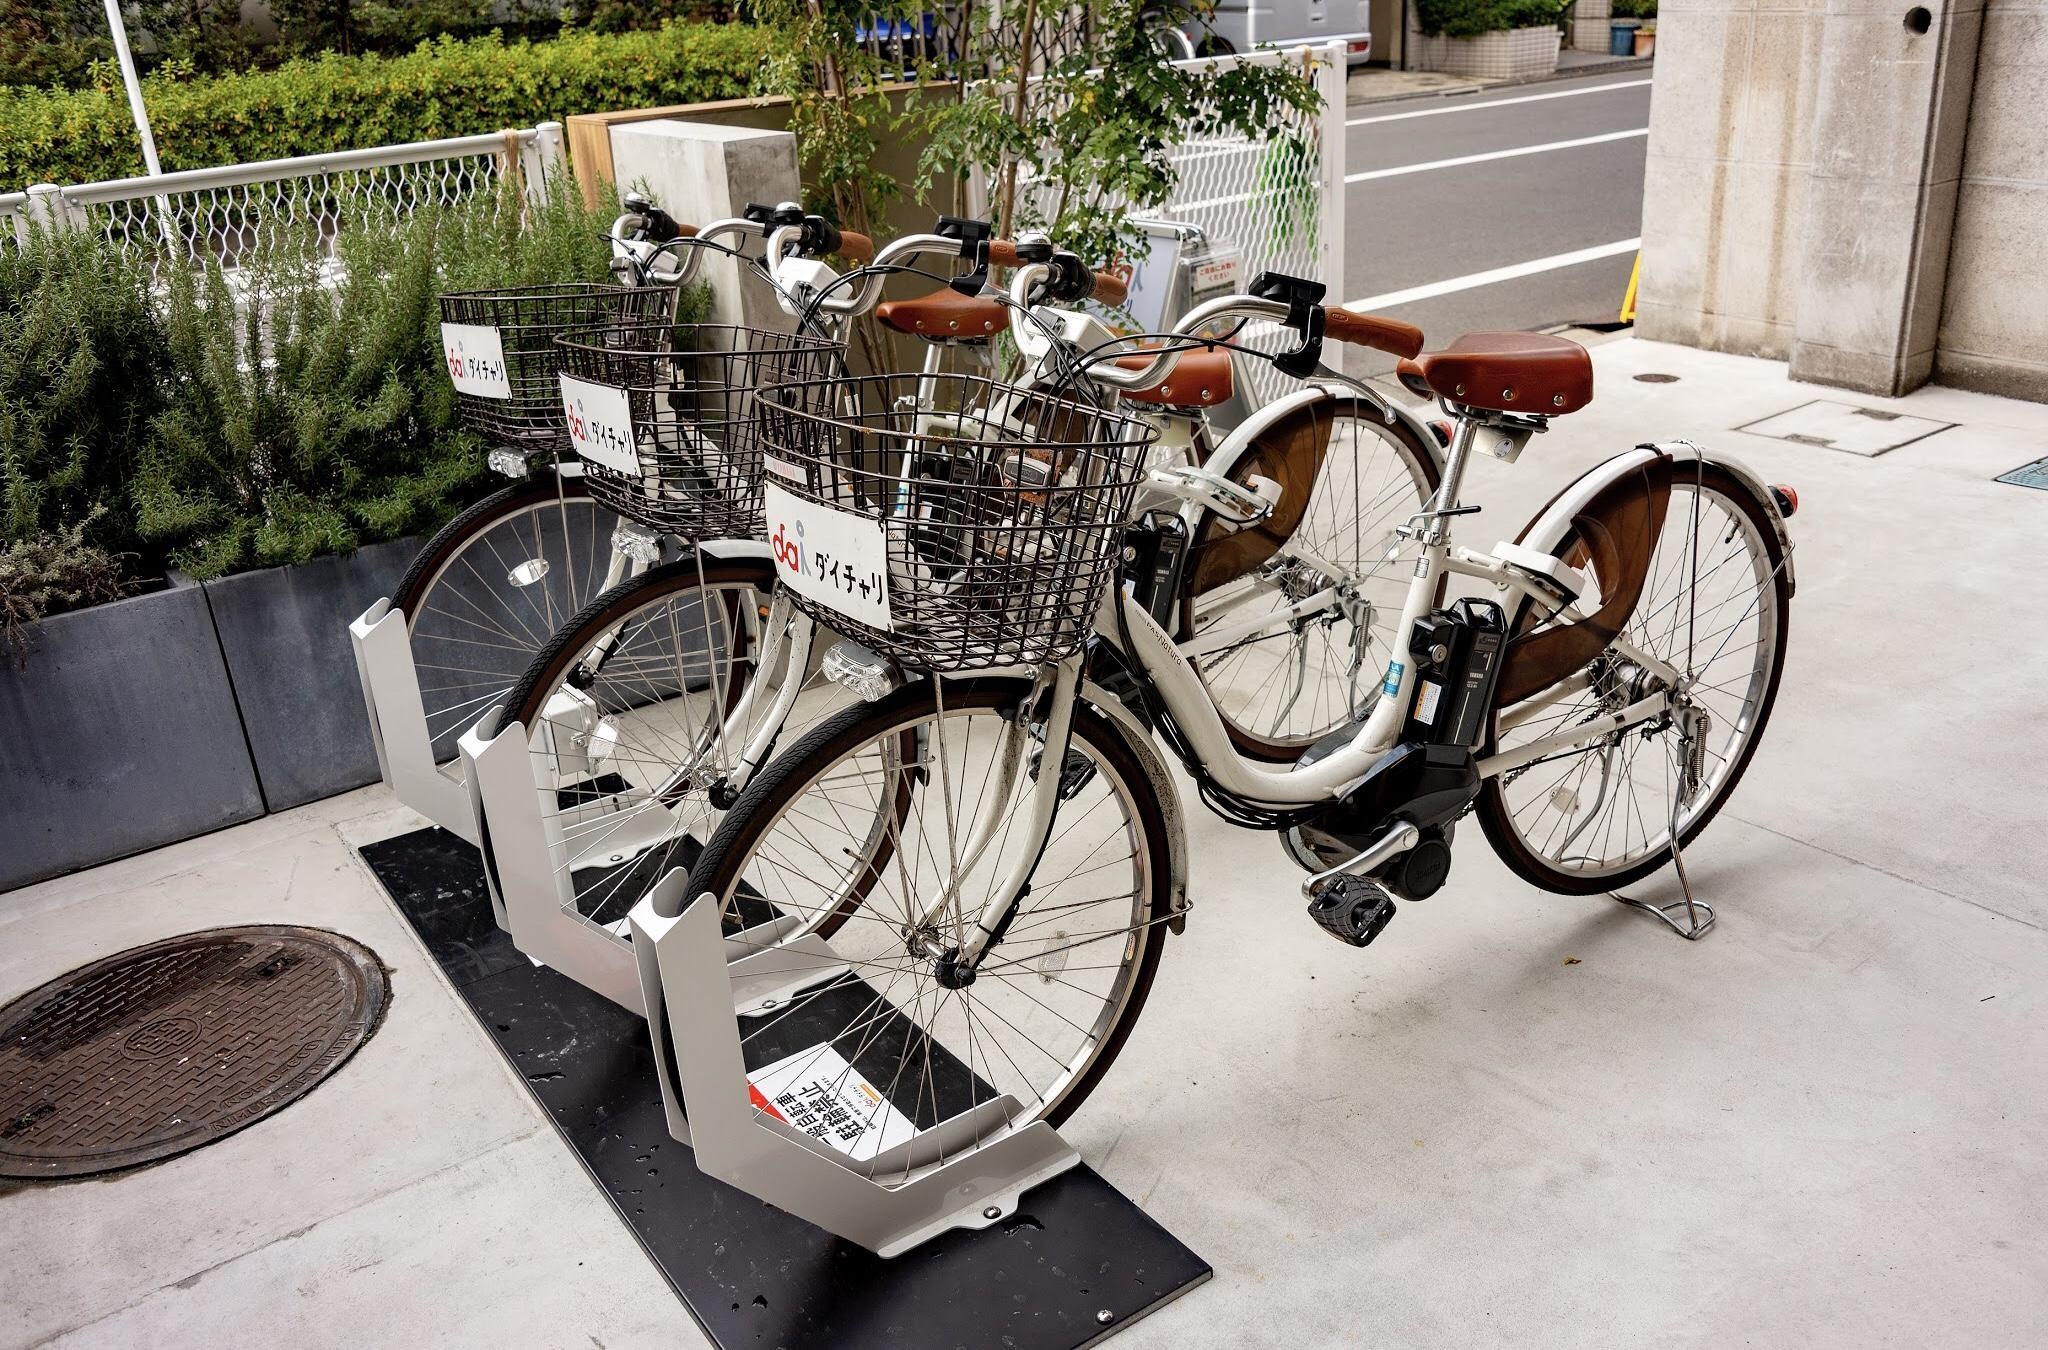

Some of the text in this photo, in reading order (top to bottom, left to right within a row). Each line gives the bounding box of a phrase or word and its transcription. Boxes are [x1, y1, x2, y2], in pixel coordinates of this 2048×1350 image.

[468, 356, 504, 382] ダイチャリ
[591, 420, 633, 457] ダイチャリ
[773, 519, 812, 577] dai
[815, 551, 883, 606] ダイチャリ
[798, 1080, 866, 1141] 駐輪禁止
